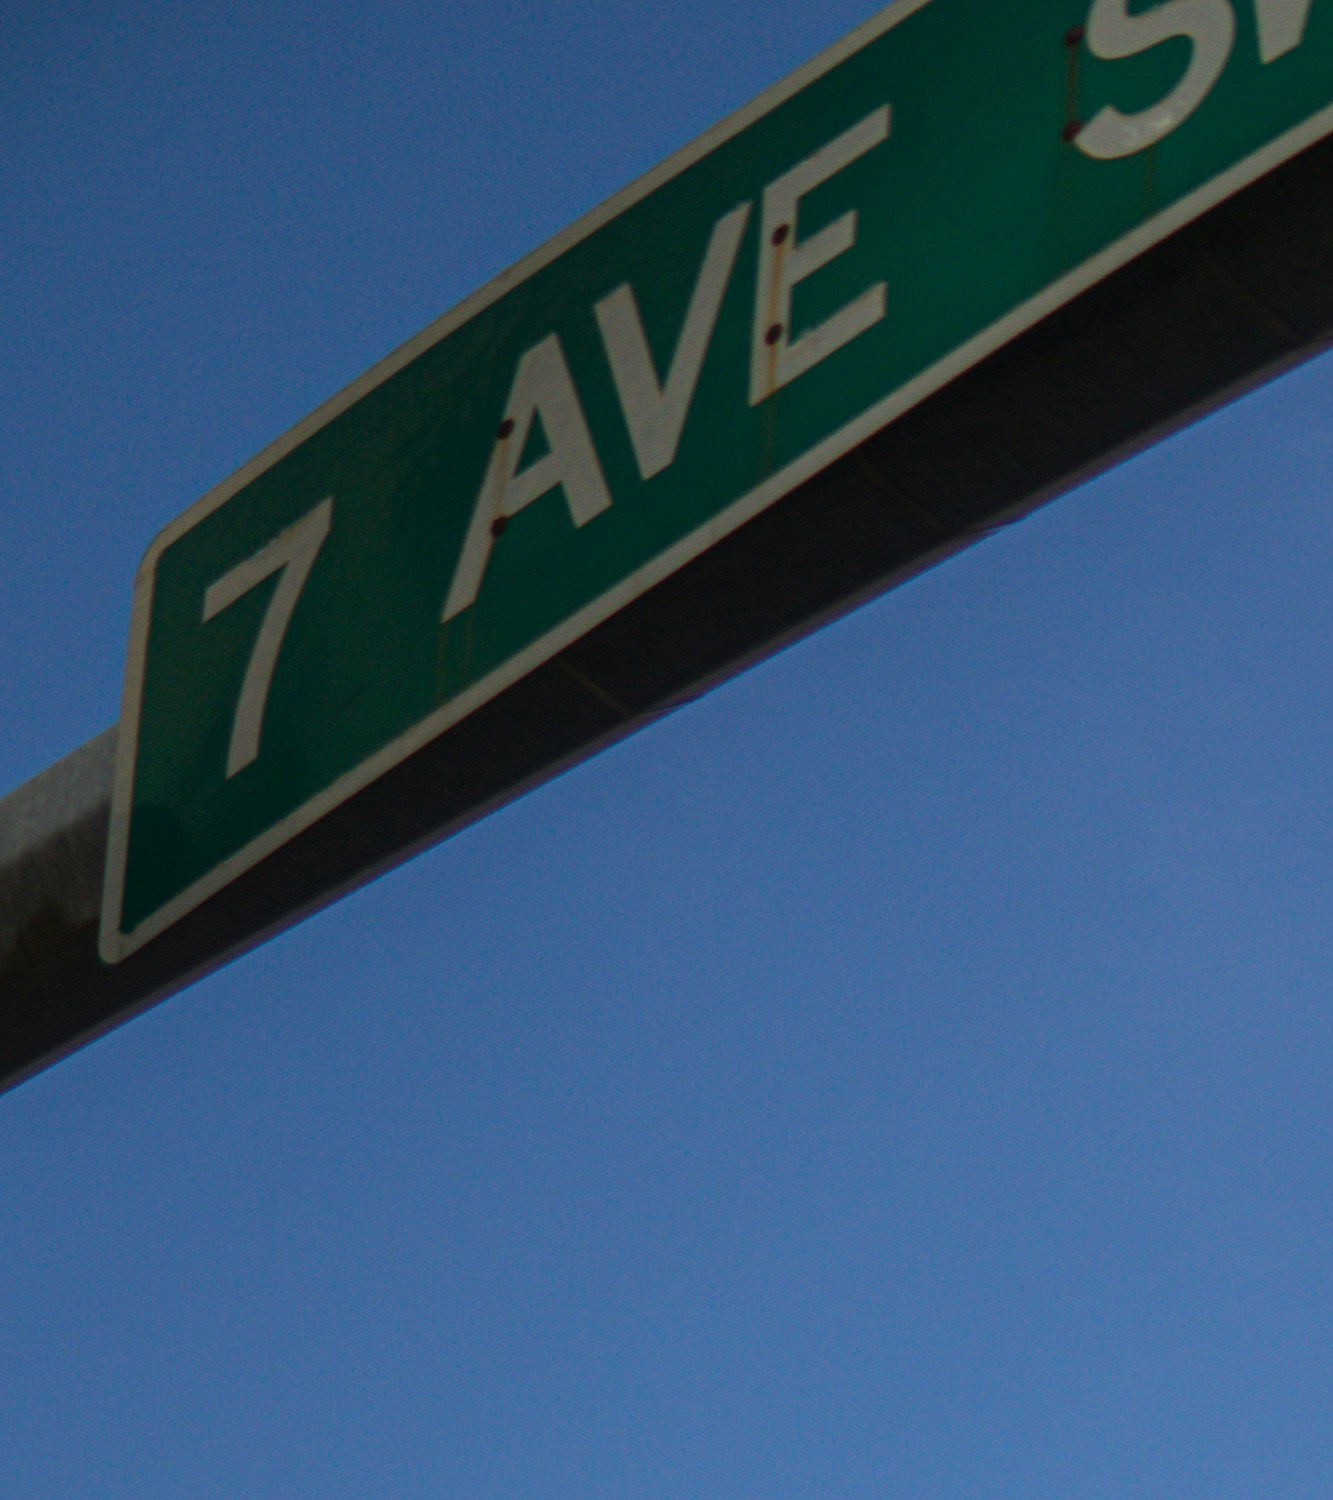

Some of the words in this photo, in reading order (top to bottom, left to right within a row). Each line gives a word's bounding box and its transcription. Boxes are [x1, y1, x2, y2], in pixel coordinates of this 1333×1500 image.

[202, 495, 334, 780] 7
[440, 103, 893, 625] AVE
[1074, 0, 1312, 161] S
